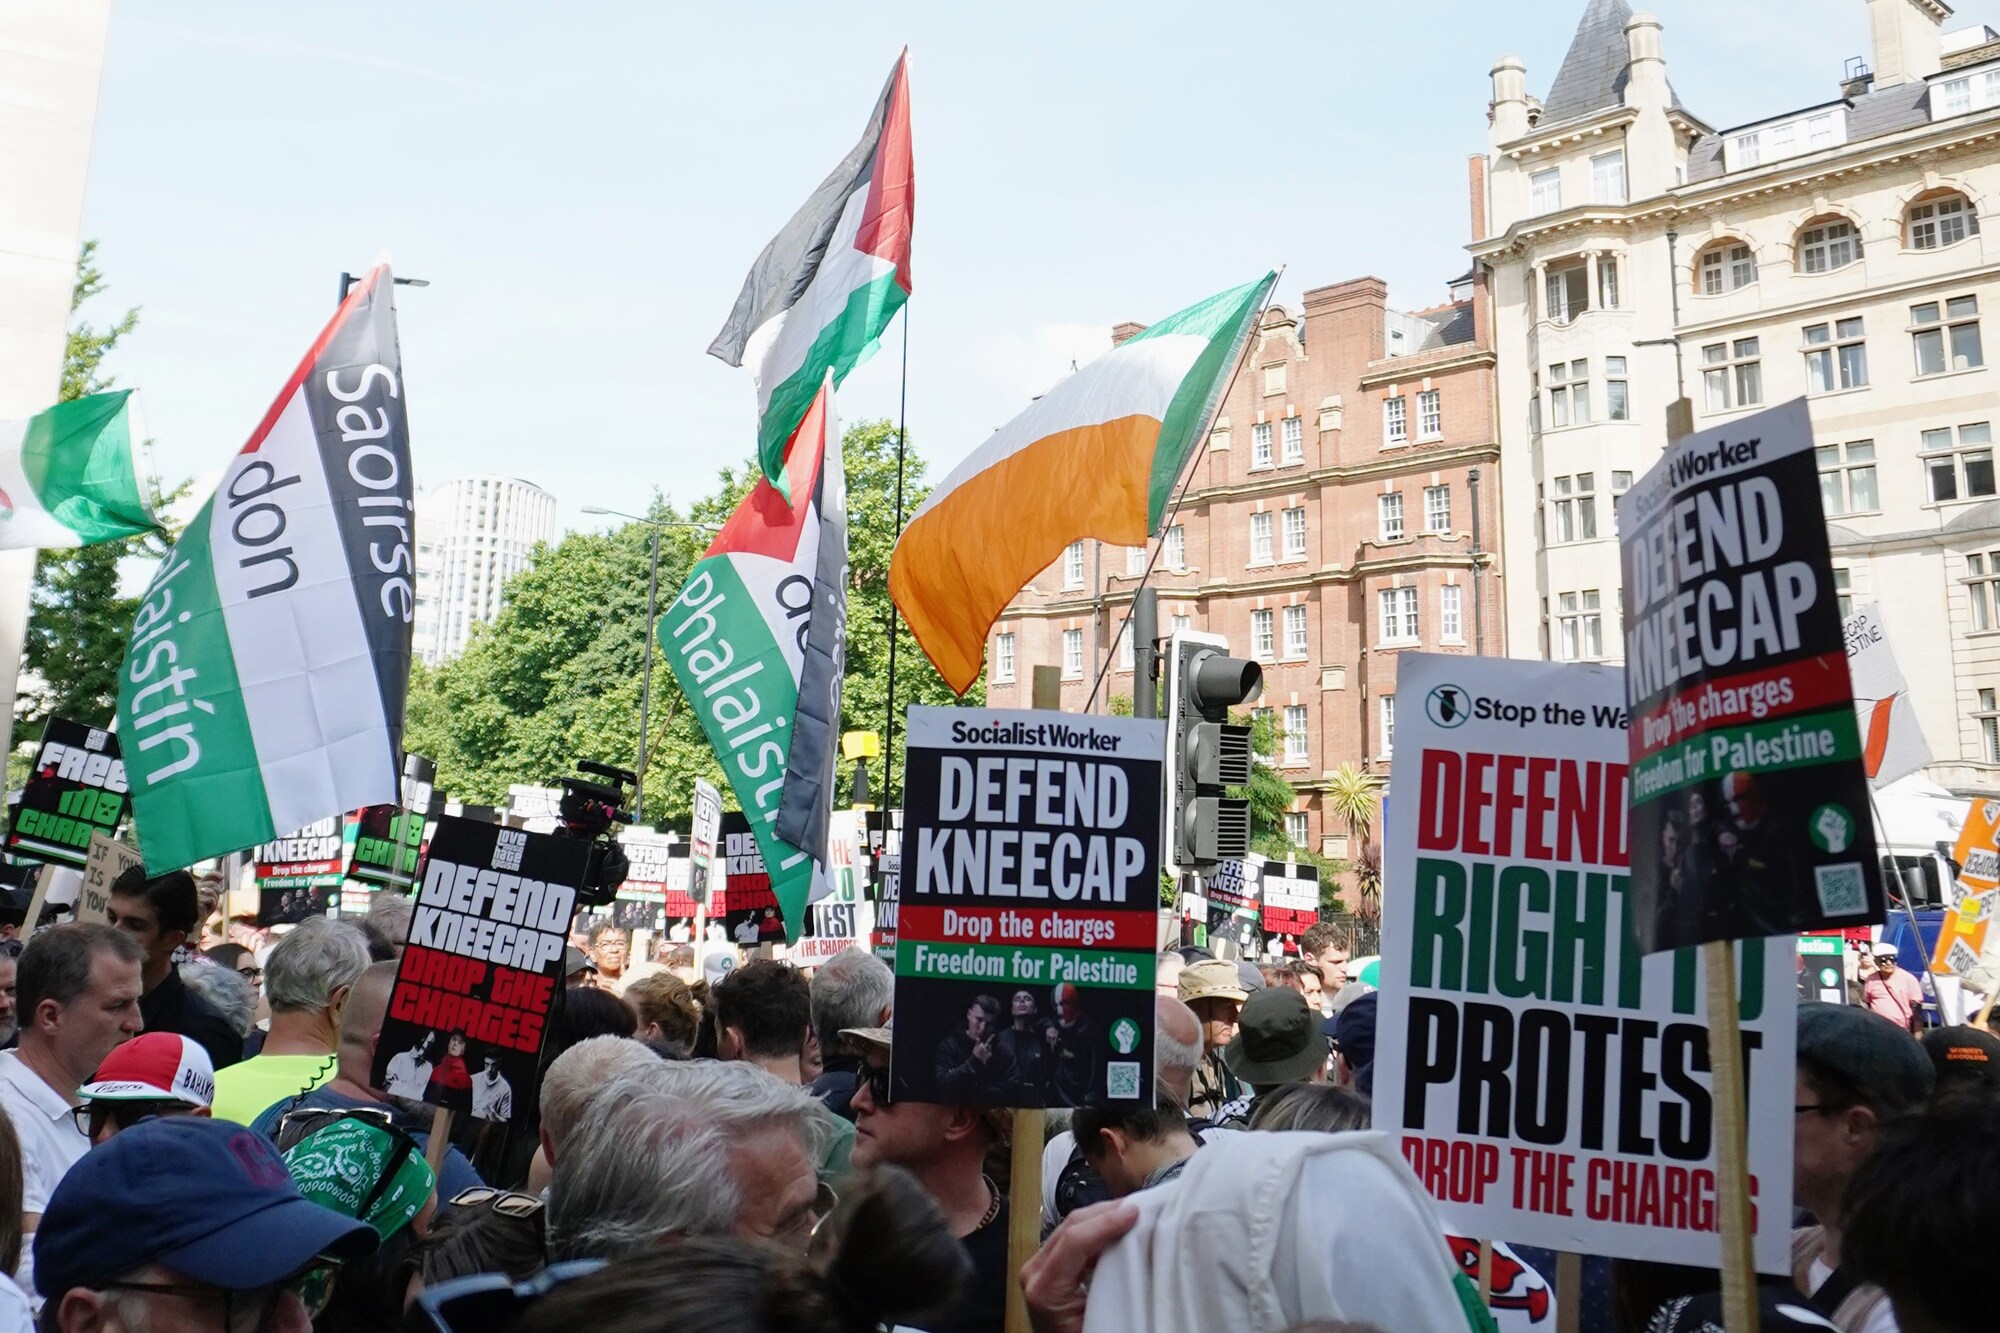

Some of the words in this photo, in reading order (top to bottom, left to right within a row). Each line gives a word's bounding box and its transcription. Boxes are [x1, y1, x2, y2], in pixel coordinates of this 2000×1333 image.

[1677, 437, 1761, 483] Worker
[326, 363, 414, 624] Saoirse
[228, 460, 302, 599] don
[1632, 475, 1784, 617] DEFEND
[1627, 560, 1818, 708] KNEECAP
[951, 720, 1047, 747] Socialist
[1047, 724, 1122, 752] Worker
[1474, 697, 1536, 728] Stop
[1543, 703, 1586, 726] the
[1643, 713, 1672, 749] Drop
[1670, 697, 1696, 733] the
[1698, 676, 1795, 719] charges
[1634, 755, 1684, 799] Freedom
[1684, 744, 1707, 779] for
[1711, 724, 1836, 771] Palestine
[938, 755, 1129, 830] DEFEND
[93, 842, 109, 861] IF
[263, 835, 341, 863] KNEECAP
[272, 865, 289, 876] Drop
[915, 827, 1146, 903] KNEECAP
[88, 866, 104, 887] IS
[943, 909, 993, 944] Drop
[999, 911, 1038, 939] the
[1039, 913, 1116, 947] charges
[1263, 905, 1294, 921] DROP
[400, 945, 486, 998] DROP
[915, 944, 1006, 978] Freedom
[1012, 947, 1045, 980] for
[1049, 951, 1138, 985] Palestine
[389, 982, 544, 1054] CHARGES
[1510, 1147, 1576, 1217] THE
